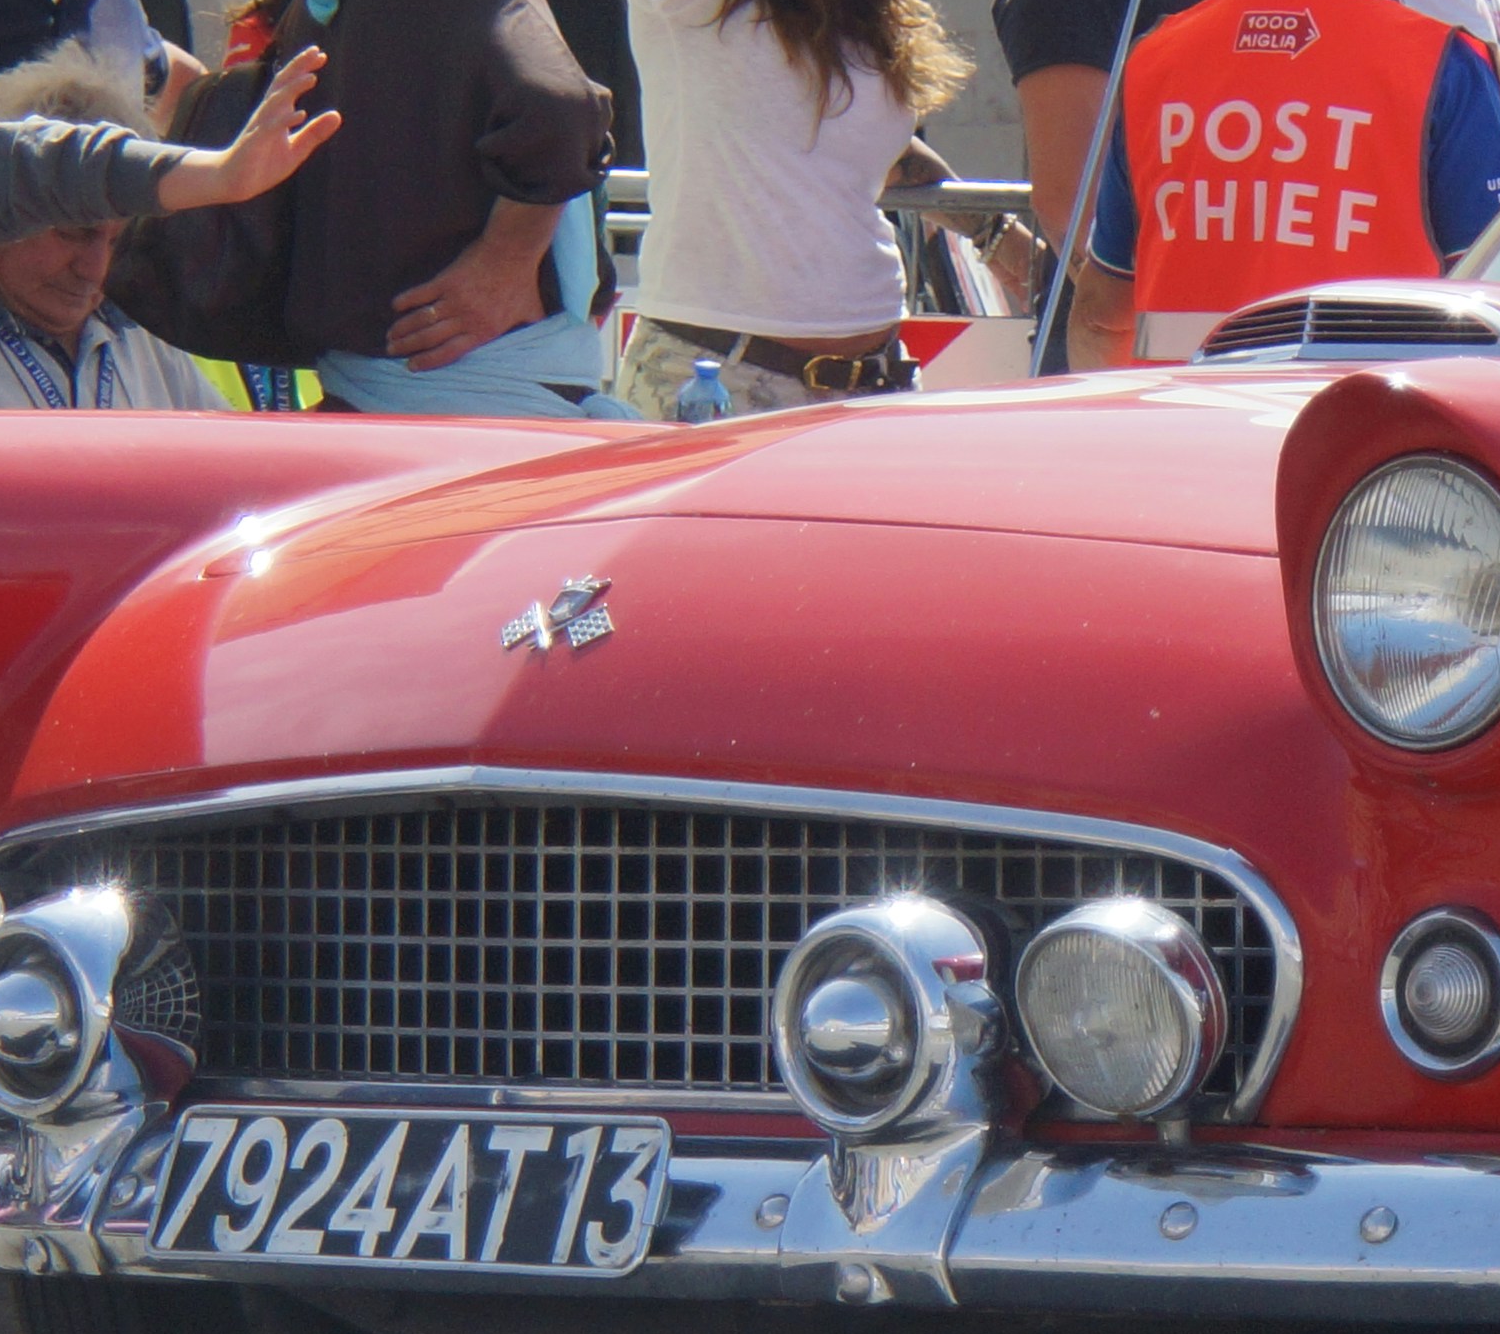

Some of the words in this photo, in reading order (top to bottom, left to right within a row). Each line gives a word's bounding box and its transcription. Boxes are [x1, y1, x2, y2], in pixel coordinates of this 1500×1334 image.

[1238, 33, 1297, 50] MIGLIA
[1247, 15, 1299, 30] 1000
[1160, 100, 1373, 171] POST
[1155, 179, 1378, 253] CHIEF
